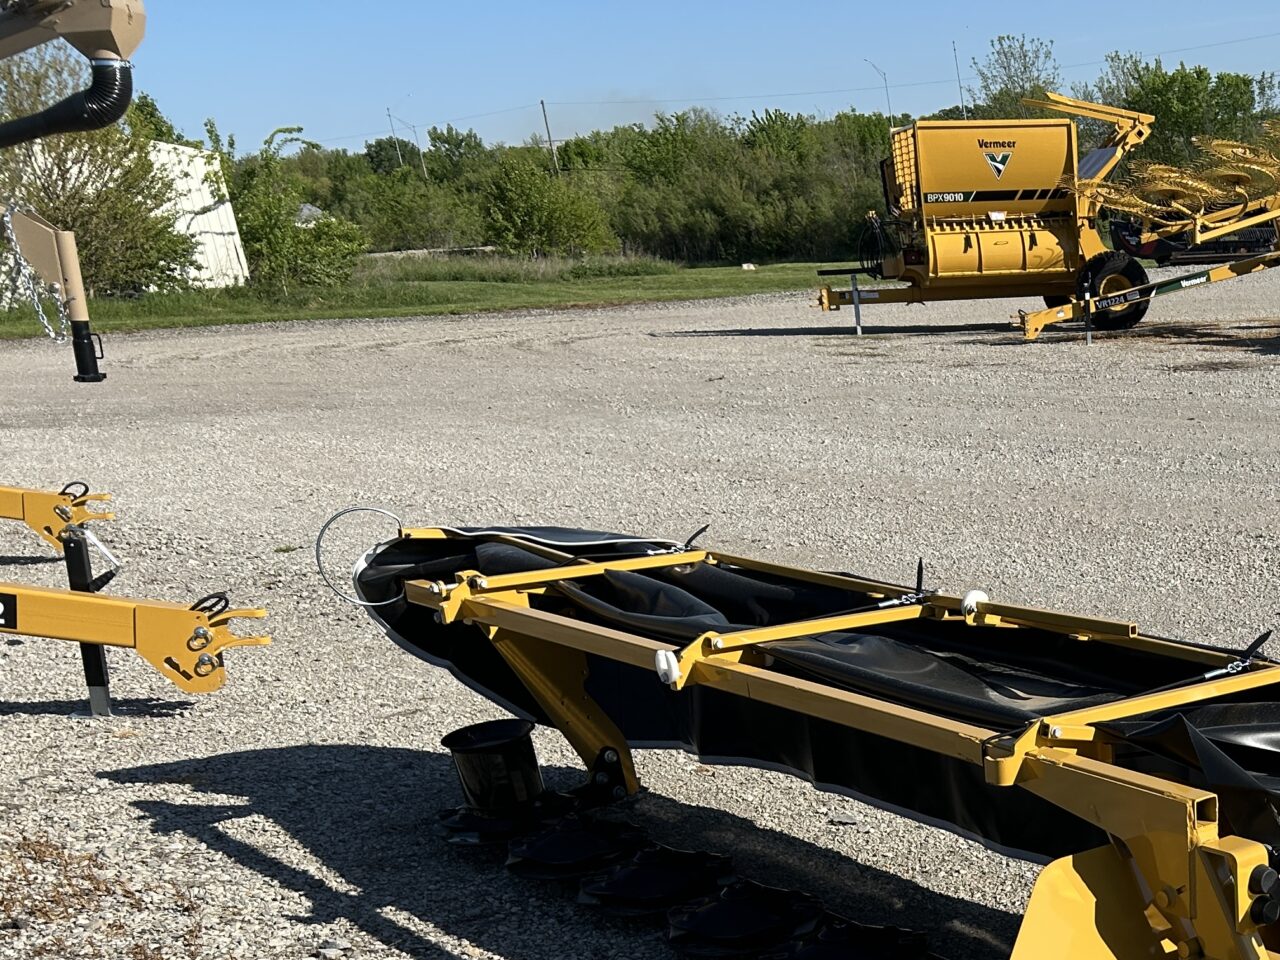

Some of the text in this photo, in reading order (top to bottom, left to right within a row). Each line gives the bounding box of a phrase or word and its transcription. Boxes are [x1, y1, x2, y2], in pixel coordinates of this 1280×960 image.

[977, 139, 1017, 149] Vermeer
[927, 193, 964, 203] BPX9010
[1180, 275, 1208, 288] Vermeer
[1096, 295, 1125, 309] VR1224
